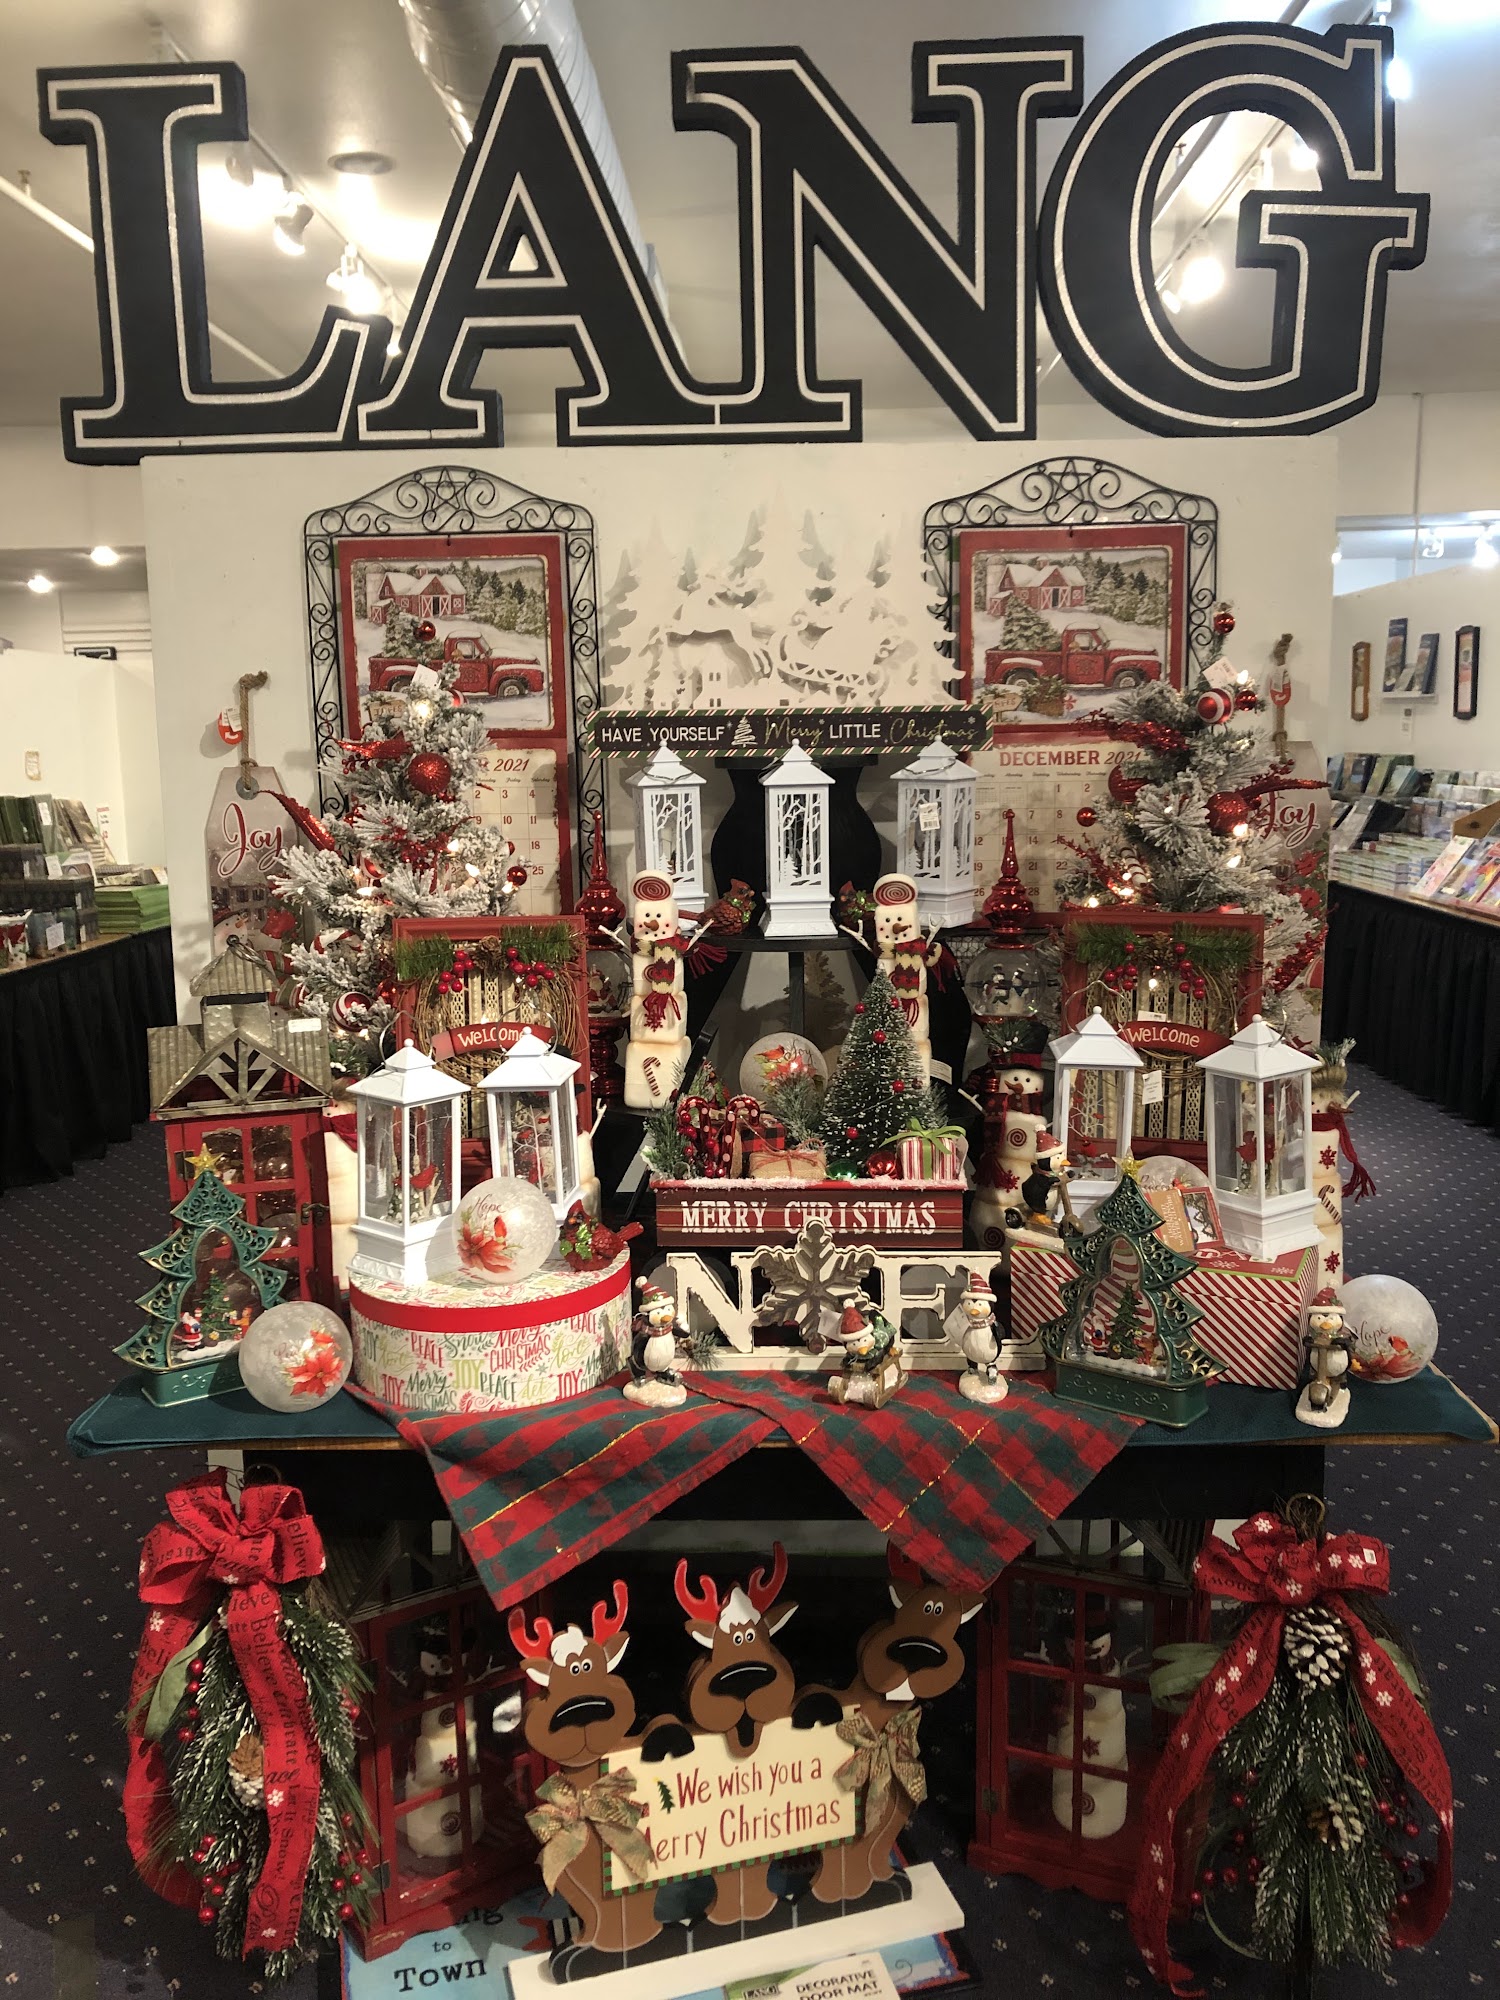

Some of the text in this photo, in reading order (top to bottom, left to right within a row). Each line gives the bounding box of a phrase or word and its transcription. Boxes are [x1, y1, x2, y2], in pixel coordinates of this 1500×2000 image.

[37, 20, 1431, 465] LANG
[602, 717, 980, 747] HAVE YOURSELF Merry LITTLE Christmas
[494, 758, 530, 772] 2021
[1000, 750, 1142, 767] DECEMBER 2021
[474, 790, 536, 799] 2 3 4
[503, 816, 512, 825] 10
[530, 816, 537, 825] 11
[1056, 810, 1063, 819] 8
[218, 802, 283, 878] Joy
[531, 841, 541, 850] 18
[1028, 836, 1038, 845] 14
[532, 866, 544, 875] 25
[1028, 862, 1038, 870] 21
[1028, 888, 1040, 897] 28
[681, 1200, 936, 1235] MERRY CHRISTMAS
[411, 1332, 444, 1368] PEACE
[406, 1370, 452, 1394] Merry
[452, 1359, 485, 1390] JOY
[480, 1370, 518, 1402] PEACE
[557, 1368, 583, 1400] JOY
[381, 1373, 405, 1405] JOY
[677, 1757, 822, 1809] We wish you a
[646, 1799, 841, 1870] erry Christmas
[431, 1941, 452, 1953] to
[394, 1958, 487, 1993] Town
[796, 1969, 877, 1994] DECORATIVE
[847, 1981, 879, 1994] MAT
